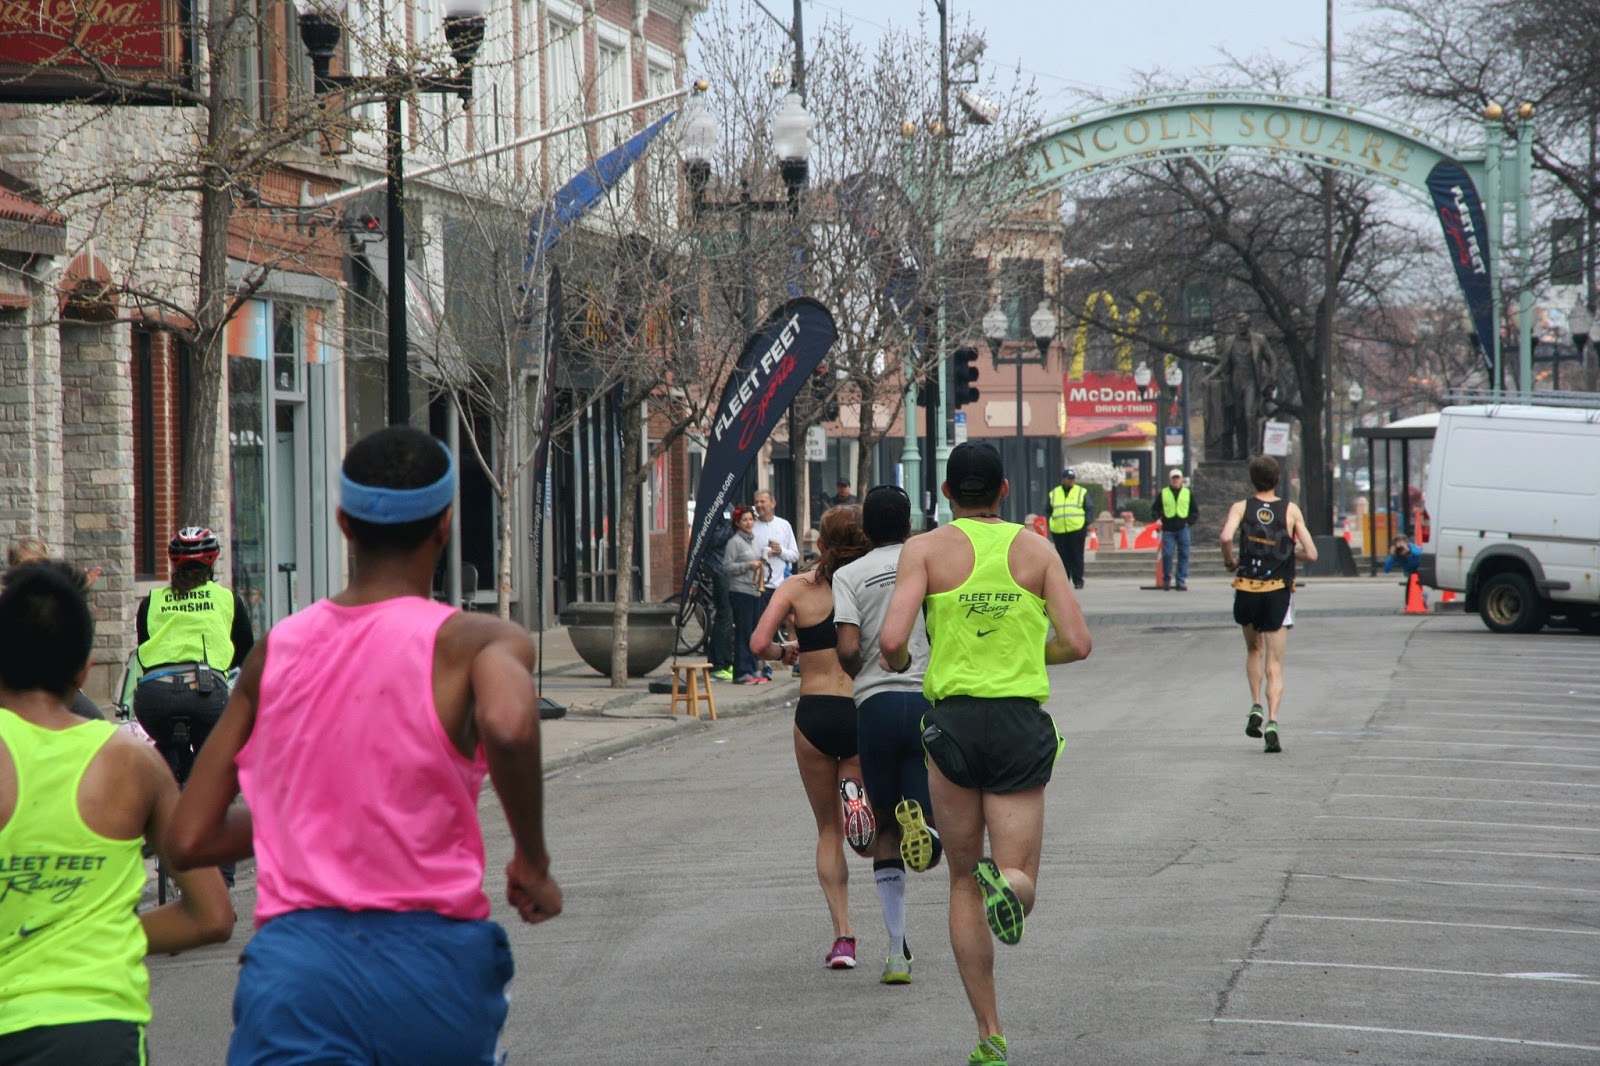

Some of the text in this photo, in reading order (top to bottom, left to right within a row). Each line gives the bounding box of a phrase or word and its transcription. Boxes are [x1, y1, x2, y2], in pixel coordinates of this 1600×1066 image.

[1238, 108, 1419, 173] SQUARE
[714, 312, 801, 442] FLEET FEET
[738, 352, 798, 450] Sports
[164, 590, 212, 603] COURSE
[958, 592, 1023, 602] FLEET FEET
[160, 601, 215, 613] MARSHAL
[961, 601, 1010, 620] Racing
[0, 855, 107, 872] LEET FEET
[0, 872, 84, 904] Racing
